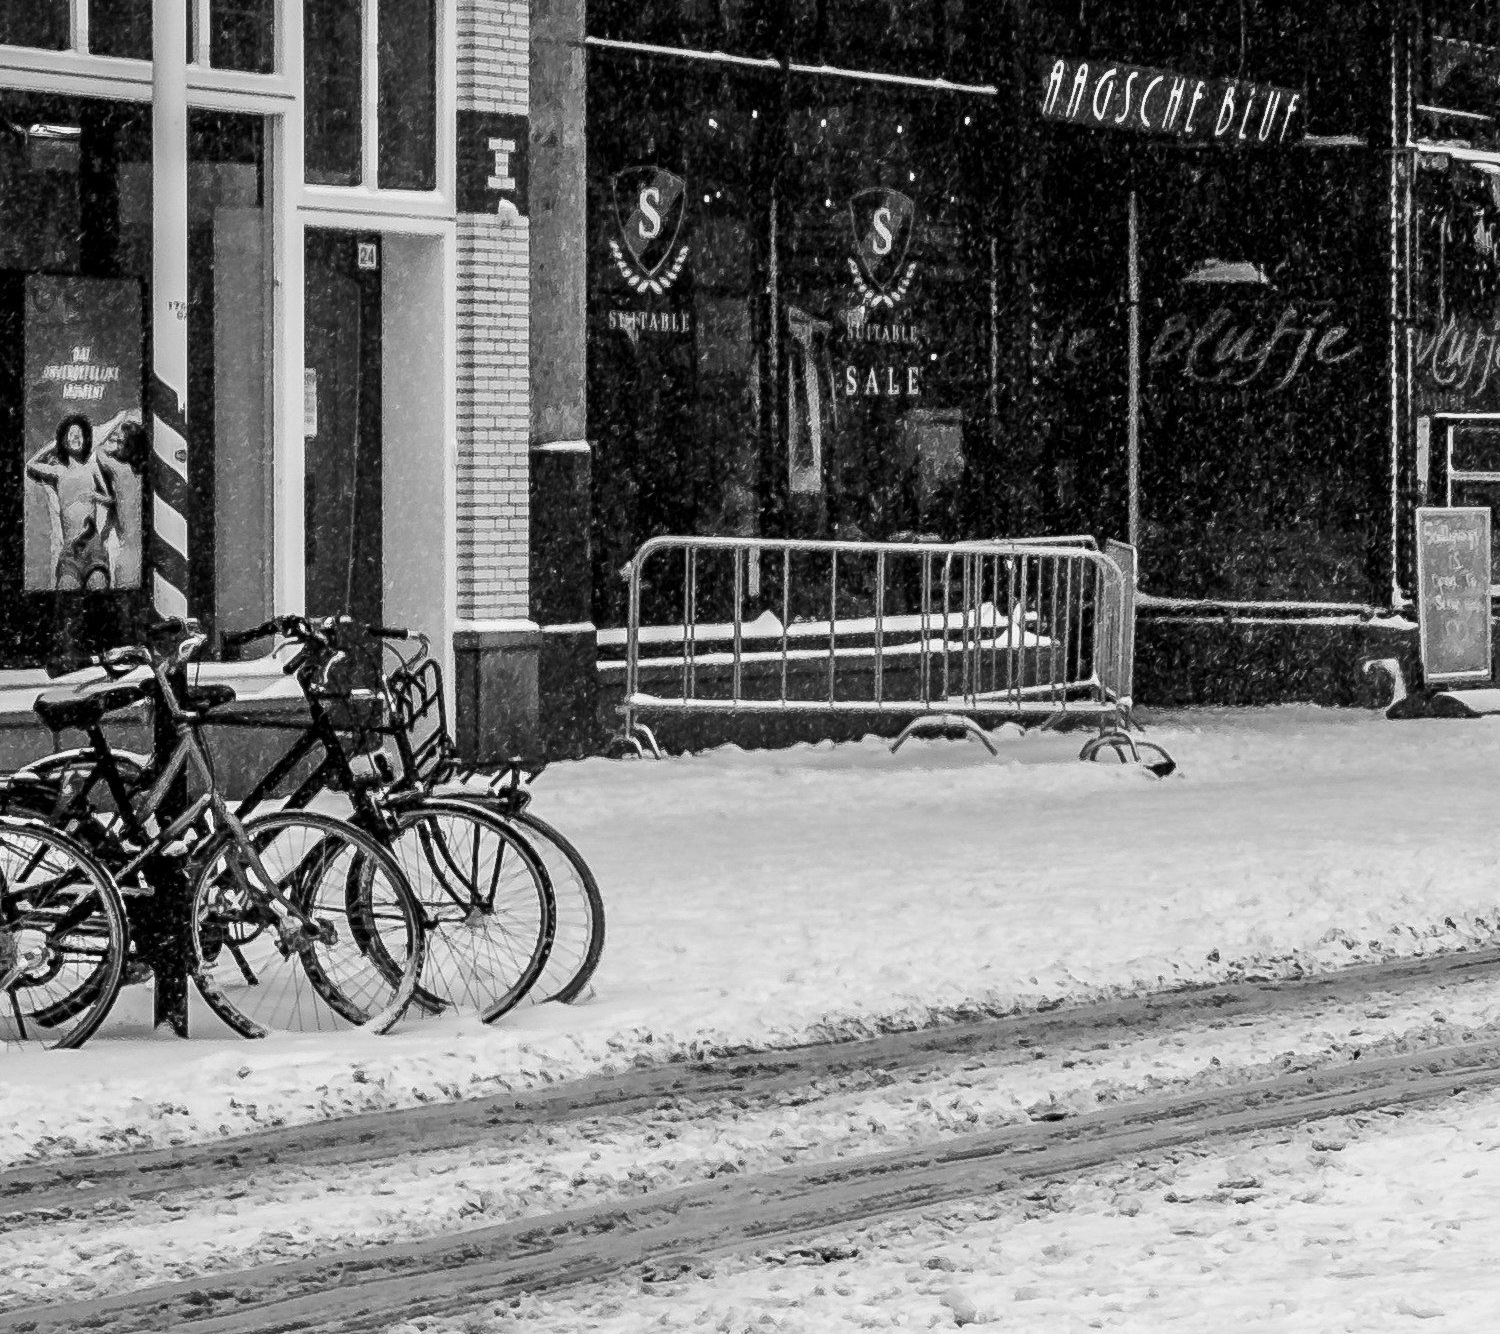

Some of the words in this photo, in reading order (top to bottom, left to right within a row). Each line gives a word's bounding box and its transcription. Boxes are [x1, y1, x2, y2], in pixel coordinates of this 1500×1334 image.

[1214, 83, 1300, 144] BLUF
[360, 246, 375, 266] 24
[609, 310, 691, 334] SUITABLE
[848, 322, 918, 343] SUITABLE
[846, 365, 921, 395] SALE
